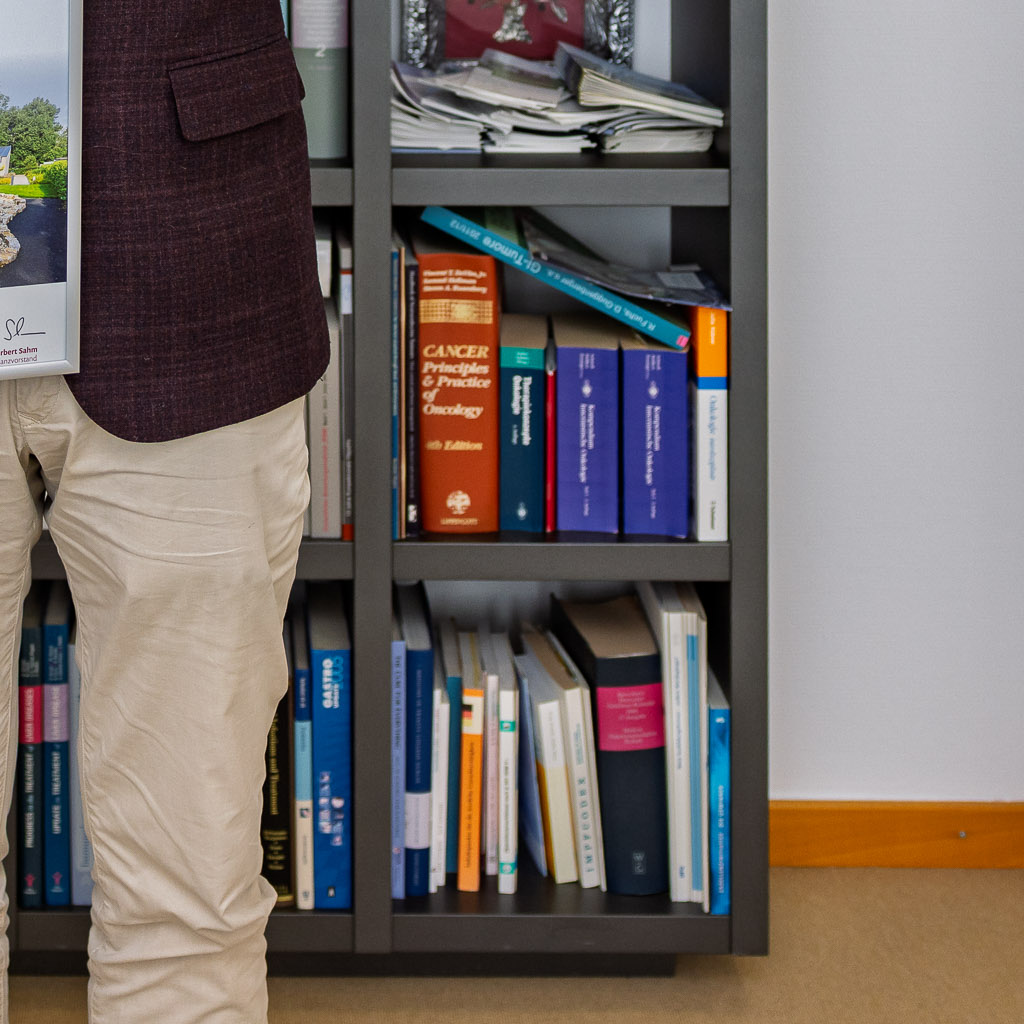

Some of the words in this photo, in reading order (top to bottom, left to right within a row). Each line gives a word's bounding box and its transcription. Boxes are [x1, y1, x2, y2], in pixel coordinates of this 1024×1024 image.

[315, 45, 326, 58] 2
[18, 346, 38, 355] Sahm
[422, 343, 489, 358] CANCER
[422, 361, 489, 377] Principles
[421, 376, 434, 387] &
[436, 376, 491, 389] Practice
[422, 388, 437, 402] of
[511, 374, 522, 415] Onkologie
[422, 403, 483, 419] Oncology
[521, 376, 532, 446] Therapiekonzepte
[587, 403, 595, 449] Kompendium
[653, 405, 662, 451] Kompendium
[579, 449, 587, 483] Onkologie
[645, 450, 654, 485] Onkologie
[322, 659, 333, 709] GASTRO
